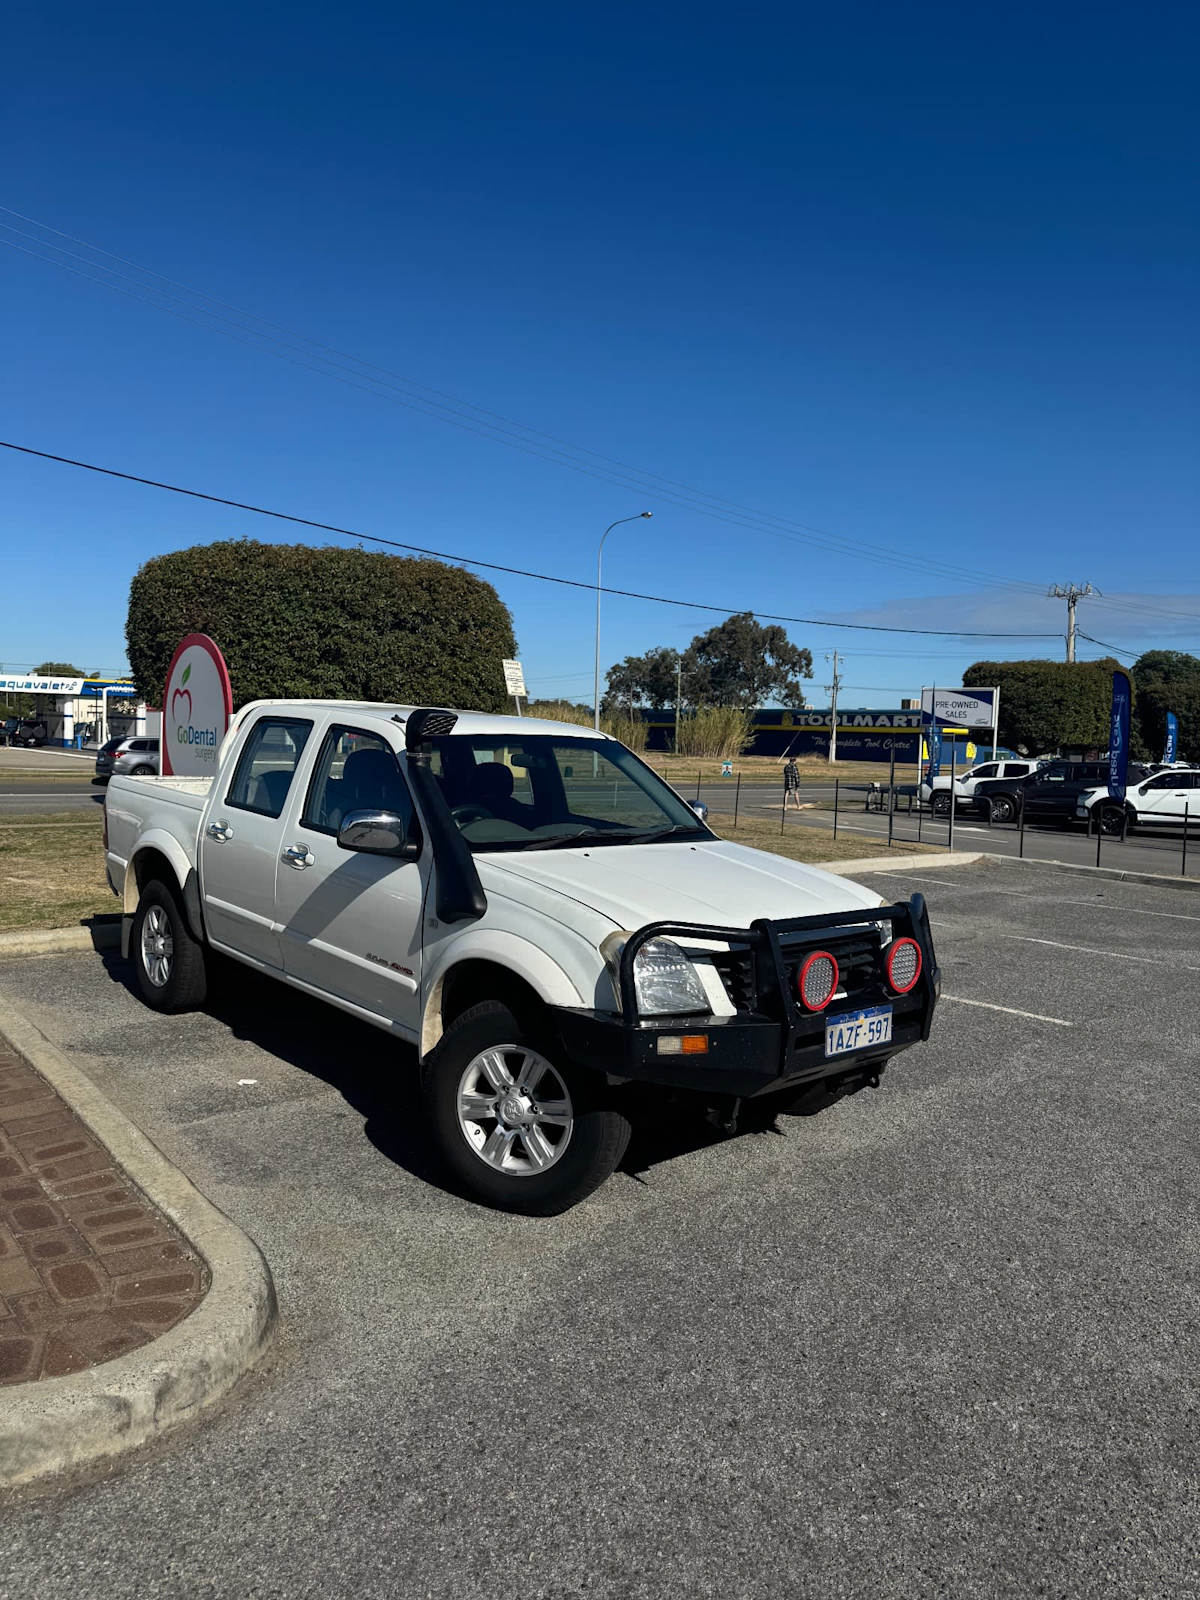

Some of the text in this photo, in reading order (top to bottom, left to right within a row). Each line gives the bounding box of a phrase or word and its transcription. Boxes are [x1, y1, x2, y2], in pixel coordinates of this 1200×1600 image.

[935, 701, 979, 709] PRE-OWNED
[945, 711, 967, 719] SALES
[796, 715, 920, 727] TOOLMART
[177, 725, 217, 746] GoDental
